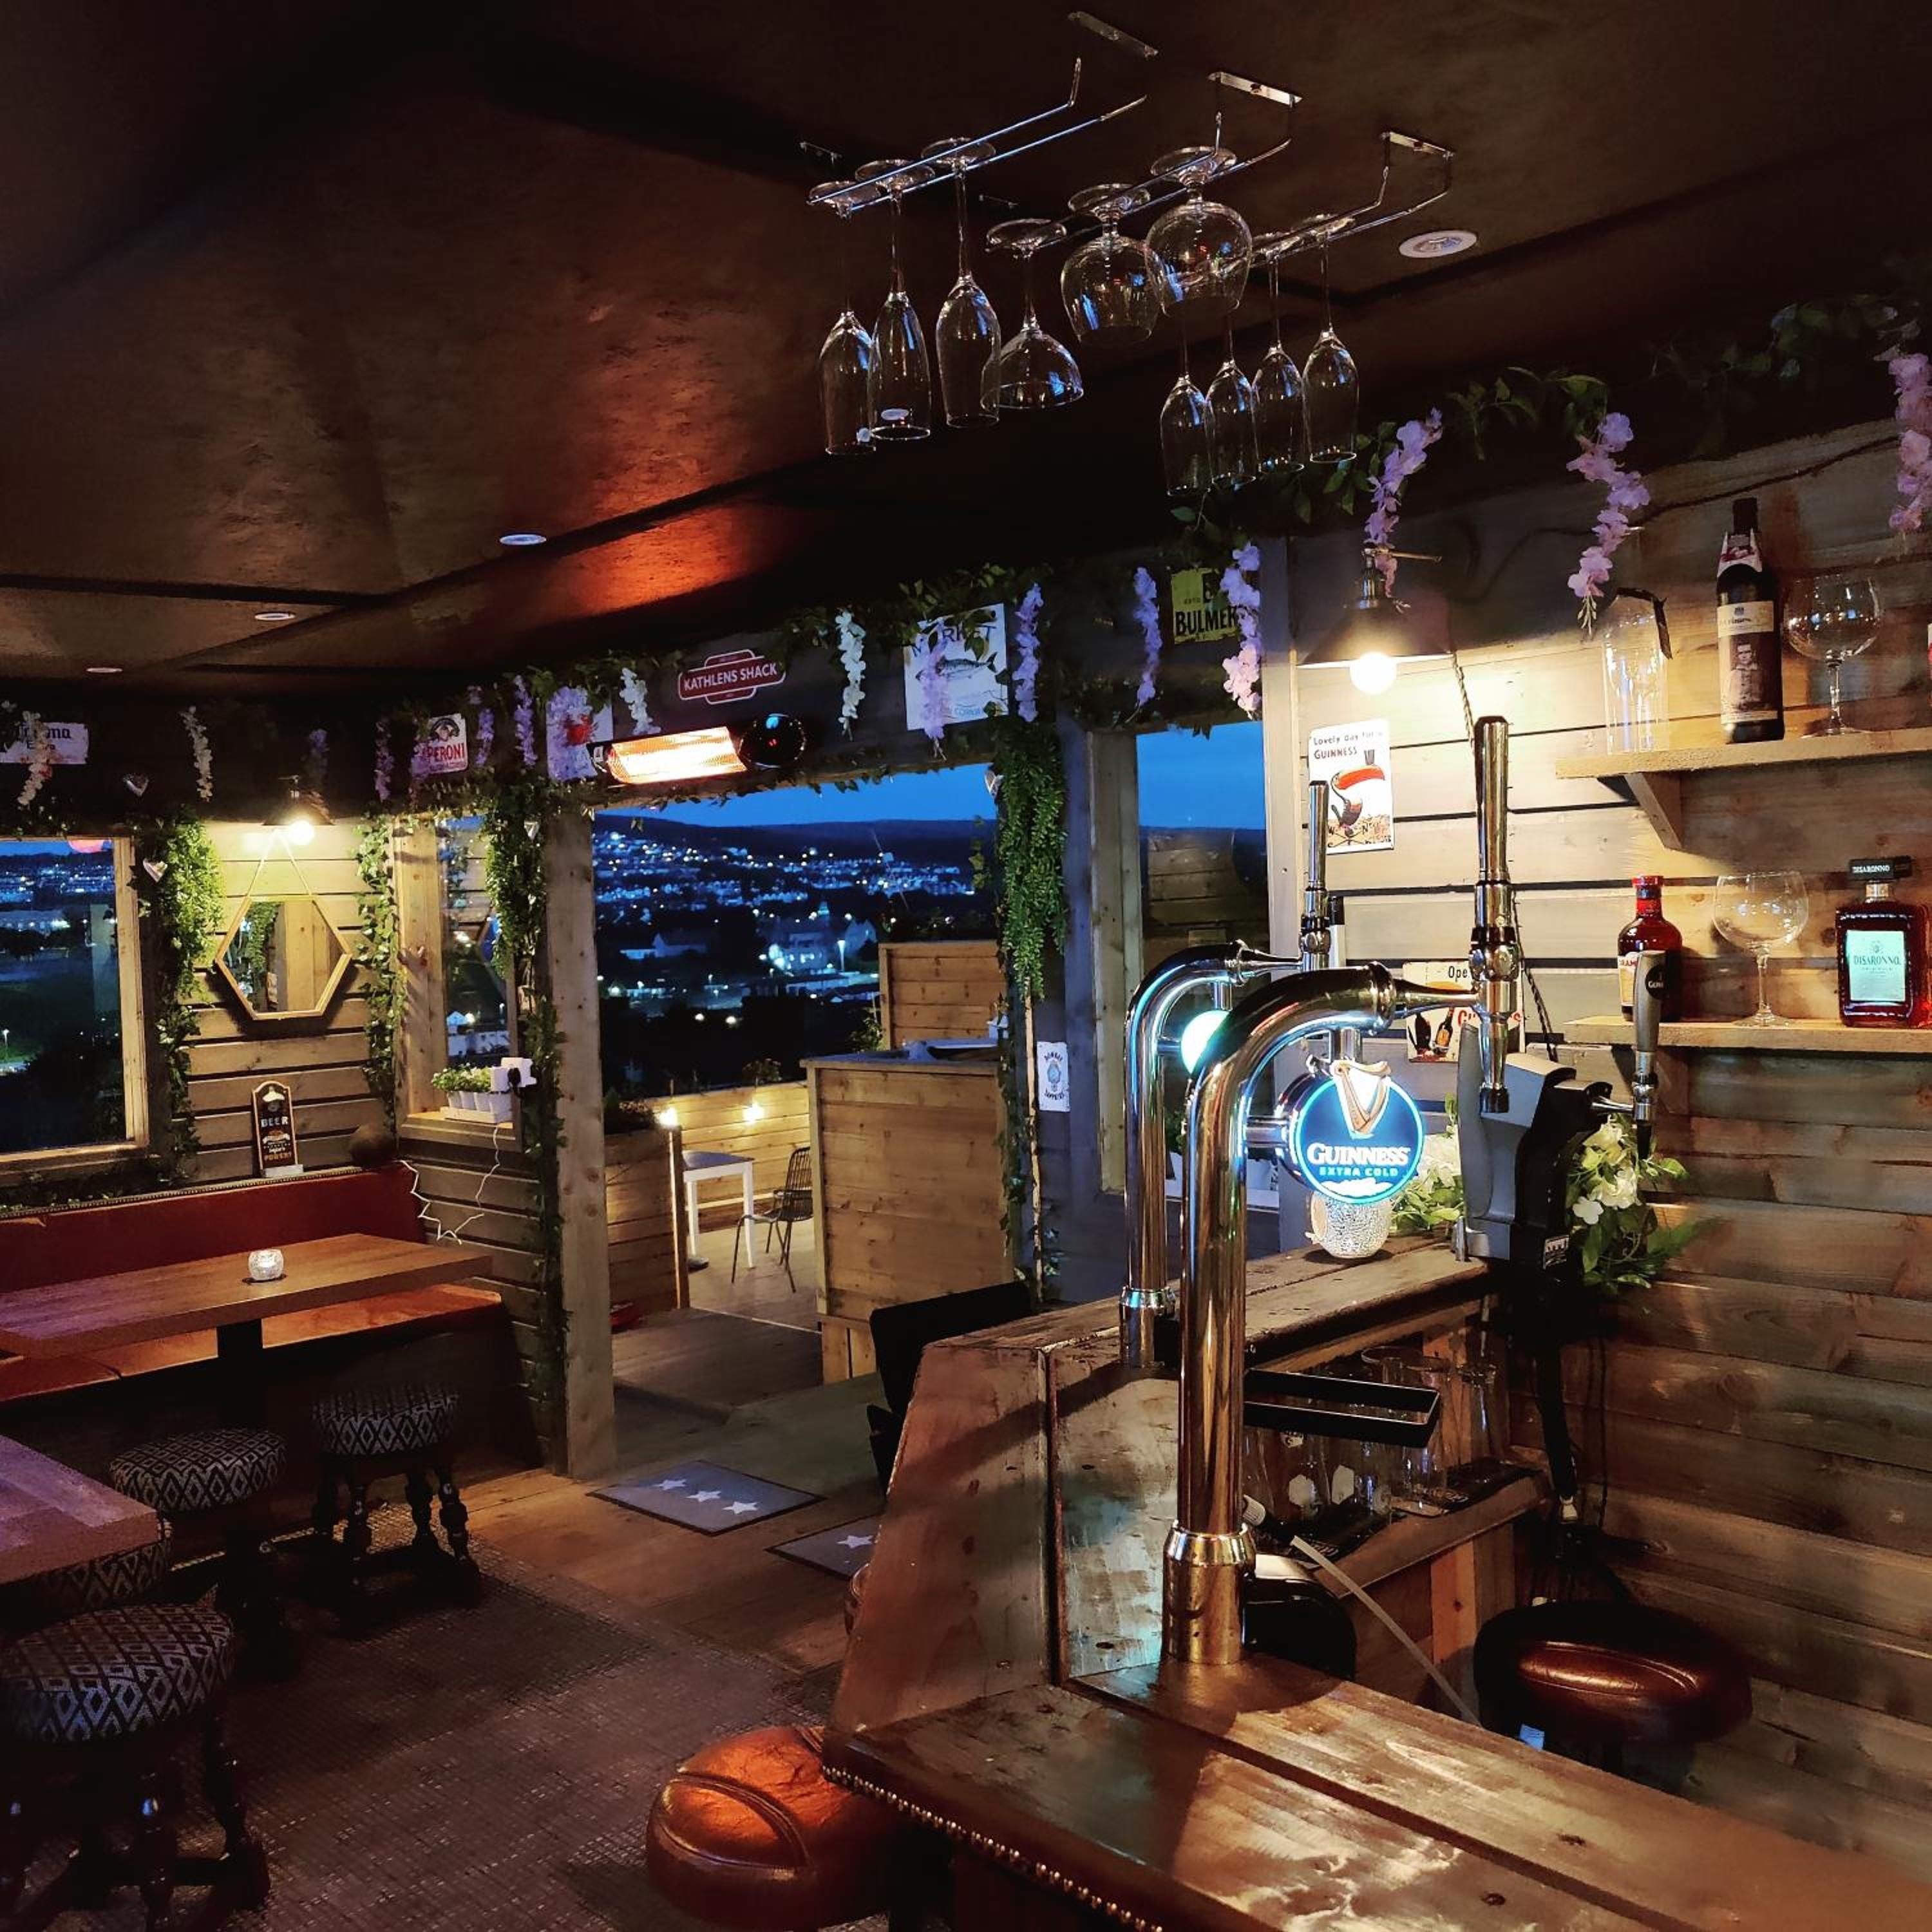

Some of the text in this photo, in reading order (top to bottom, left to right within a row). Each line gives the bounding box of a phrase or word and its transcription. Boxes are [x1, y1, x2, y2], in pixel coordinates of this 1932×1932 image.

[1175, 605, 1238, 637] BULMER
[684, 662, 777, 691] KATHLENS SHACK
[1313, 735, 1340, 746] Lovely
[428, 743, 464, 761] PERONI
[1313, 746, 1358, 760] GUINNESS
[1852, 864, 1890, 873] DISARONNO
[1854, 955, 1899, 965] DISARONNO
[1448, 965, 1470, 983] Ope
[261, 1116, 289, 1128] BEER
[1307, 1142, 1411, 1166] GUINNESS
[1319, 1166, 1399, 1177] EXTRA COLD
